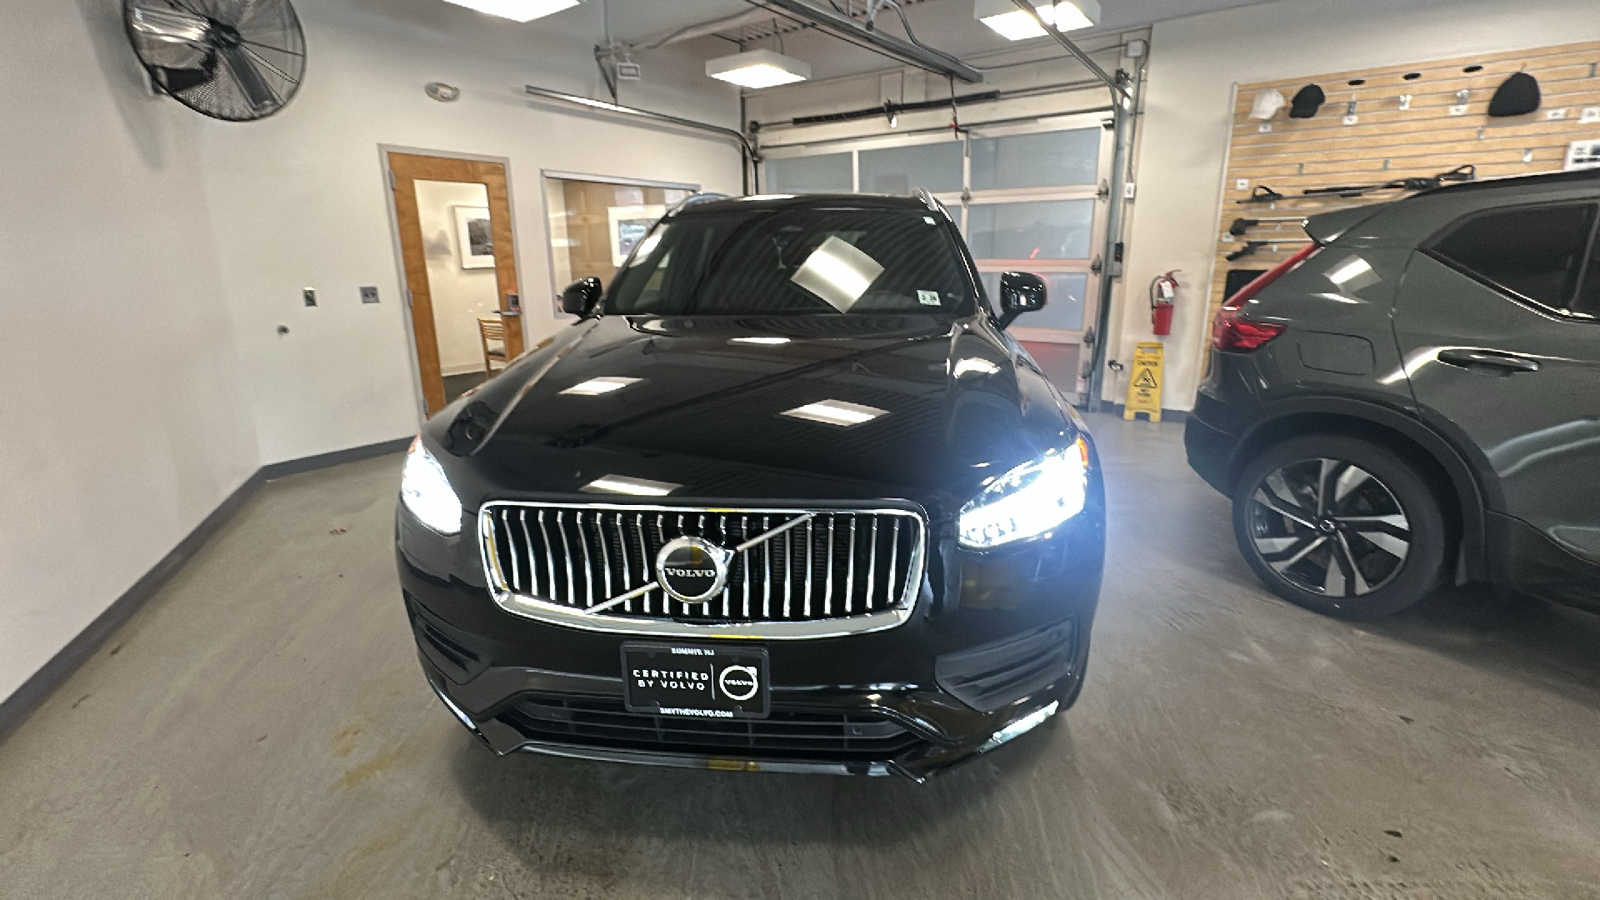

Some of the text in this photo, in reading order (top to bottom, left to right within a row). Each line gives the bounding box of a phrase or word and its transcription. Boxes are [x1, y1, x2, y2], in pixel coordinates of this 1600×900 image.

[664, 567, 716, 578] VOLVO
[632, 669, 709, 681] CERTIFIED
[637, 679, 706, 691] BY VOLVO
